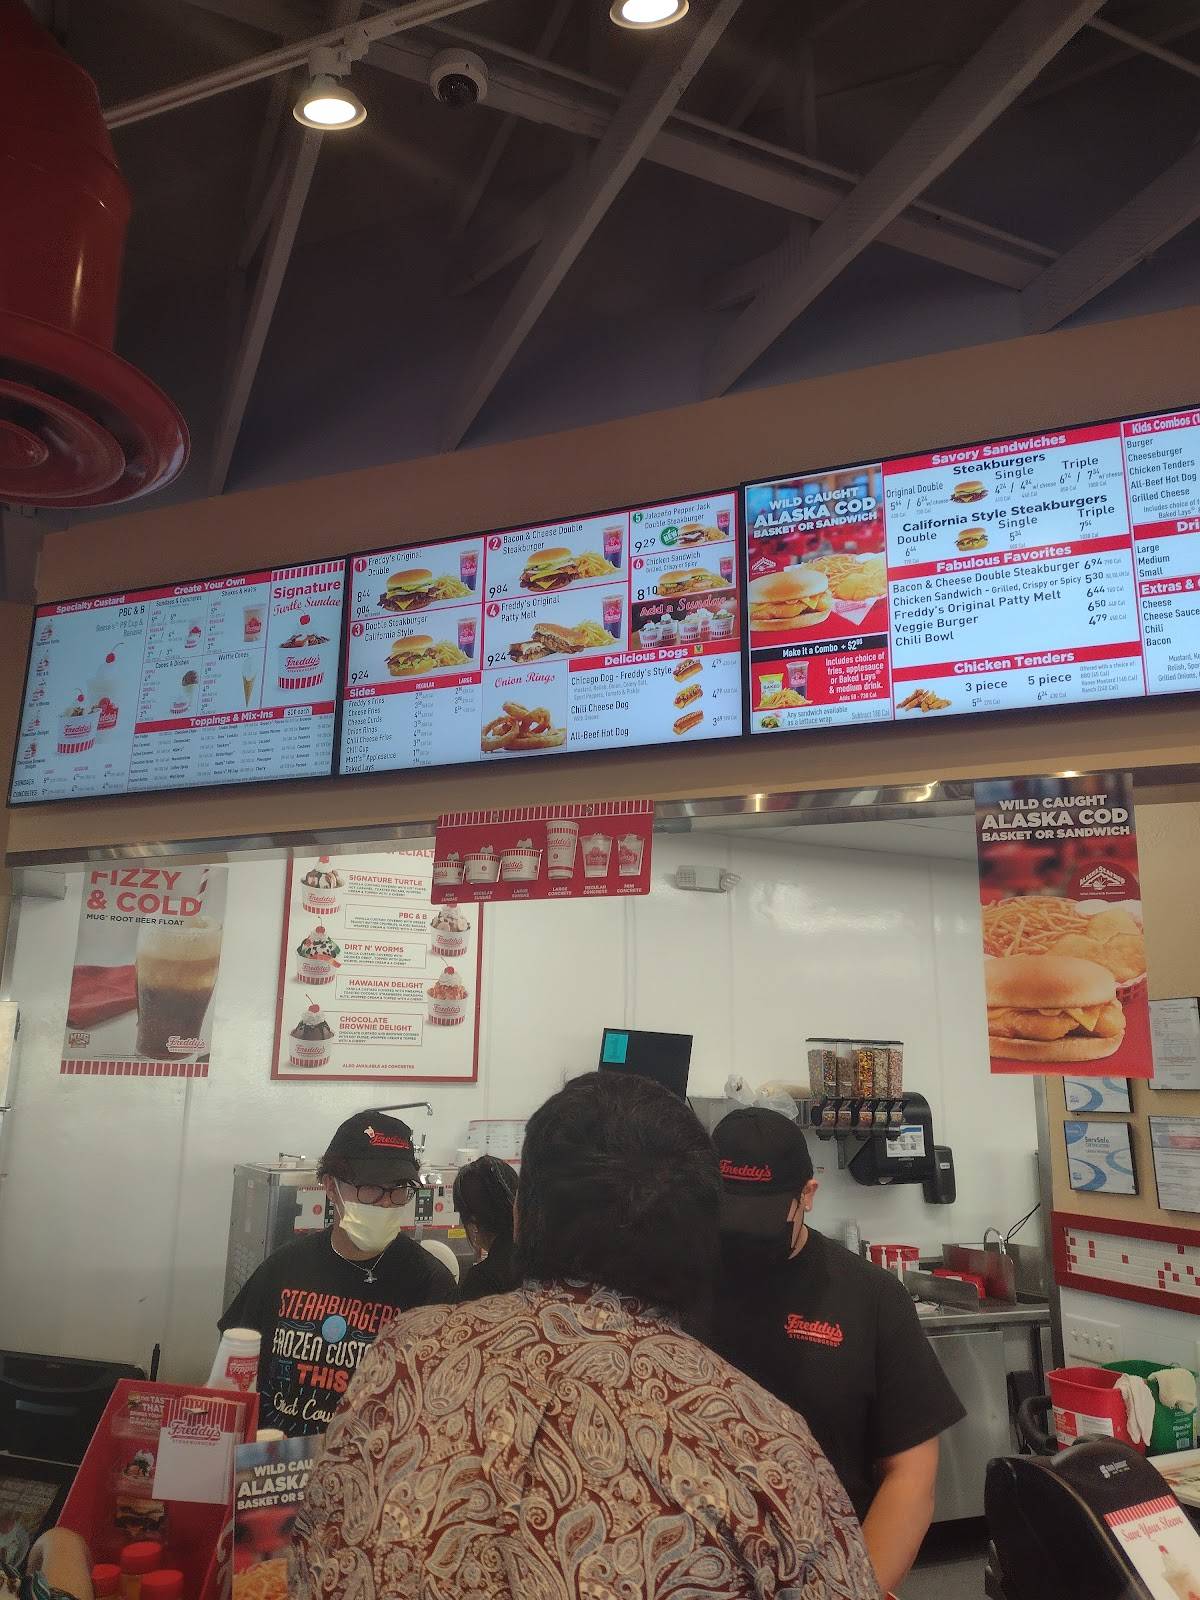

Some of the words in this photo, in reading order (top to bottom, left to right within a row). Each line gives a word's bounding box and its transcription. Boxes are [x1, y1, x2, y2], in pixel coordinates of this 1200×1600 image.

[1132, 423, 1152, 434] Kids
[1154, 417, 1190, 430] Combos
[932, 449, 980, 464] Savory
[983, 434, 1066, 456] Sandwiches
[1126, 438, 1154, 449] Burger
[1128, 448, 1182, 462] Cheeseburger
[953, 453, 1046, 475] Steakburgers
[995, 466, 1034, 480] Single
[1062, 456, 1099, 470] Triple
[1130, 464, 1161, 476] Chicken
[1162, 459, 1195, 471] Tenders
[1130, 476, 1163, 490] All-Beef
[1166, 475, 1179, 485] Hot
[1181, 473, 1196, 482] Dog
[769, 497, 802, 510] WILD
[805, 487, 860, 504] CAUGHT
[886, 486, 916, 499] Original
[917, 482, 944, 493] Double
[1132, 492, 1158, 503] Grilled
[1160, 488, 1190, 498] Cheese
[754, 504, 830, 528] ALASKA
[834, 496, 876, 514] COD
[902, 515, 968, 532] California
[971, 509, 1007, 523] Style
[1011, 494, 1108, 516] Steakburgers
[1144, 503, 1168, 512] Includes
[1169, 500, 1188, 509] choice
[1158, 510, 1177, 518] Baked
[754, 524, 796, 538] BASKET
[798, 522, 814, 532] OR
[816, 512, 878, 528] SANDWICH
[897, 532, 937, 545] Double
[998, 516, 1038, 529] Single
[1078, 504, 1115, 518] Triple
[503, 534, 524, 544] Bacon
[526, 532, 530, 540] &
[532, 528, 557, 539] Cheese
[558, 524, 583, 535] Double
[503, 542, 544, 555] Steakburger
[671, 551, 701, 562] Sandwich
[1136, 544, 1160, 554] Large
[936, 556, 1000, 572] Fabulous
[1003, 546, 1072, 564] Favorites
[1138, 554, 1170, 566] Medium
[893, 582, 922, 594] Bacon
[925, 581, 932, 589] &
[936, 576, 972, 588] Cheese
[975, 569, 1011, 582] Double
[1014, 560, 1080, 576] Steakburger
[1139, 567, 1164, 578] Small
[174, 584, 202, 595] Create
[204, 580, 224, 590] Your
[226, 578, 246, 588] Own
[273, 580, 341, 600] Signature
[894, 594, 932, 606] Chicken
[934, 587, 982, 601] Sandwich
[991, 583, 1020, 594] Grilled,
[1022, 578, 1048, 590] Crispy
[1060, 576, 1082, 586] Spicy
[1141, 582, 1182, 596] Extras
[56, 600, 92, 614] Specialty
[94, 595, 126, 608] Custard
[273, 600, 302, 616] Turtle
[304, 595, 341, 608] Sundae
[501, 600, 531, 612] Freddy's
[532, 594, 560, 606] Original
[894, 605, 944, 620] Freddy's
[948, 598, 996, 613] Original
[998, 594, 1030, 607] Patty
[1034, 590, 1061, 602] Melt
[1142, 599, 1172, 609] Cheese
[118, 608, 132, 618] PBC
[501, 612, 518, 622] Patty
[520, 610, 536, 619] Melt
[1144, 610, 1174, 621] Cheese
[1175, 608, 1200, 619] Sauce
[894, 621, 934, 634] Veggie
[937, 616, 978, 628] Burger
[1144, 624, 1164, 634] Chili
[895, 634, 922, 646] Chili
[925, 631, 954, 643] Bowl
[1146, 637, 1172, 646] Bacon
[604, 652, 656, 667] Delicious
[658, 647, 688, 660] Dogs
[782, 648, 801, 658] Make
[814, 644, 838, 655] Combo
[826, 656, 854, 666] Includes
[854, 654, 876, 662] choice
[954, 659, 1011, 674] Chicken
[1014, 652, 1075, 668] Tenders
[571, 674, 599, 687] Chicago
[600, 672, 614, 684] Dog
[620, 668, 651, 680] Freddy's
[652, 666, 672, 677] Style
[846, 663, 884, 675] applesauce
[494, 676, 522, 688] Onion
[838, 673, 859, 683] Baked
[965, 682, 973, 692] 3
[976, 680, 1008, 694] piece
[1028, 676, 1035, 686] 5
[1038, 672, 1072, 686] piece
[348, 687, 376, 698] Sides
[836, 683, 862, 693] medium
[570, 704, 588, 715] Chili
[588, 702, 614, 713] Cheese
[615, 700, 629, 710] Dog
[190, 714, 232, 728] Toppings
[232, 714, 239, 722] &
[241, 710, 274, 722] Mix-Ins
[570, 730, 600, 741] All-Beef
[601, 728, 614, 738] Hot
[615, 727, 629, 738] Dog
[1000, 799, 1039, 811] WILD
[1042, 794, 1108, 808] CAUGHT
[982, 810, 1074, 830] ALASKA
[1078, 808, 1128, 825] COD
[982, 830, 1032, 842] BASKET
[1035, 829, 1054, 839] OR
[1056, 826, 1130, 838] SANDWICH
[90, 868, 182, 890] FIZZY
[348, 874, 392, 884] SIGNATURE
[394, 878, 424, 886] TURTLE
[86, 890, 108, 911] &
[116, 892, 203, 917] COLD
[158, 918, 184, 926] FLOAT
[399, 912, 414, 920] PBC
[344, 944, 362, 952] DIRT
[374, 945, 404, 953] WORMS
[348, 980, 390, 988] HAWAIIAN
[340, 1016, 388, 1024] CHOCOLATE
[379, 1024, 412, 1032] DELIGHT
[166, 1036, 207, 1048] Freddy's
[719, 1159, 773, 1182] Freddy's
[784, 1314, 844, 1341] Freddy's
[272, 1328, 324, 1362] FROZEN
[326, 1340, 372, 1369] CUST
[296, 1363, 349, 1393] THIS
[167, 1420, 221, 1441] Freddy's
[254, 1463, 286, 1477] WILD
[288, 1459, 313, 1472] CAU
[237, 1495, 279, 1510] BASKET
[280, 1492, 296, 1504] OR
